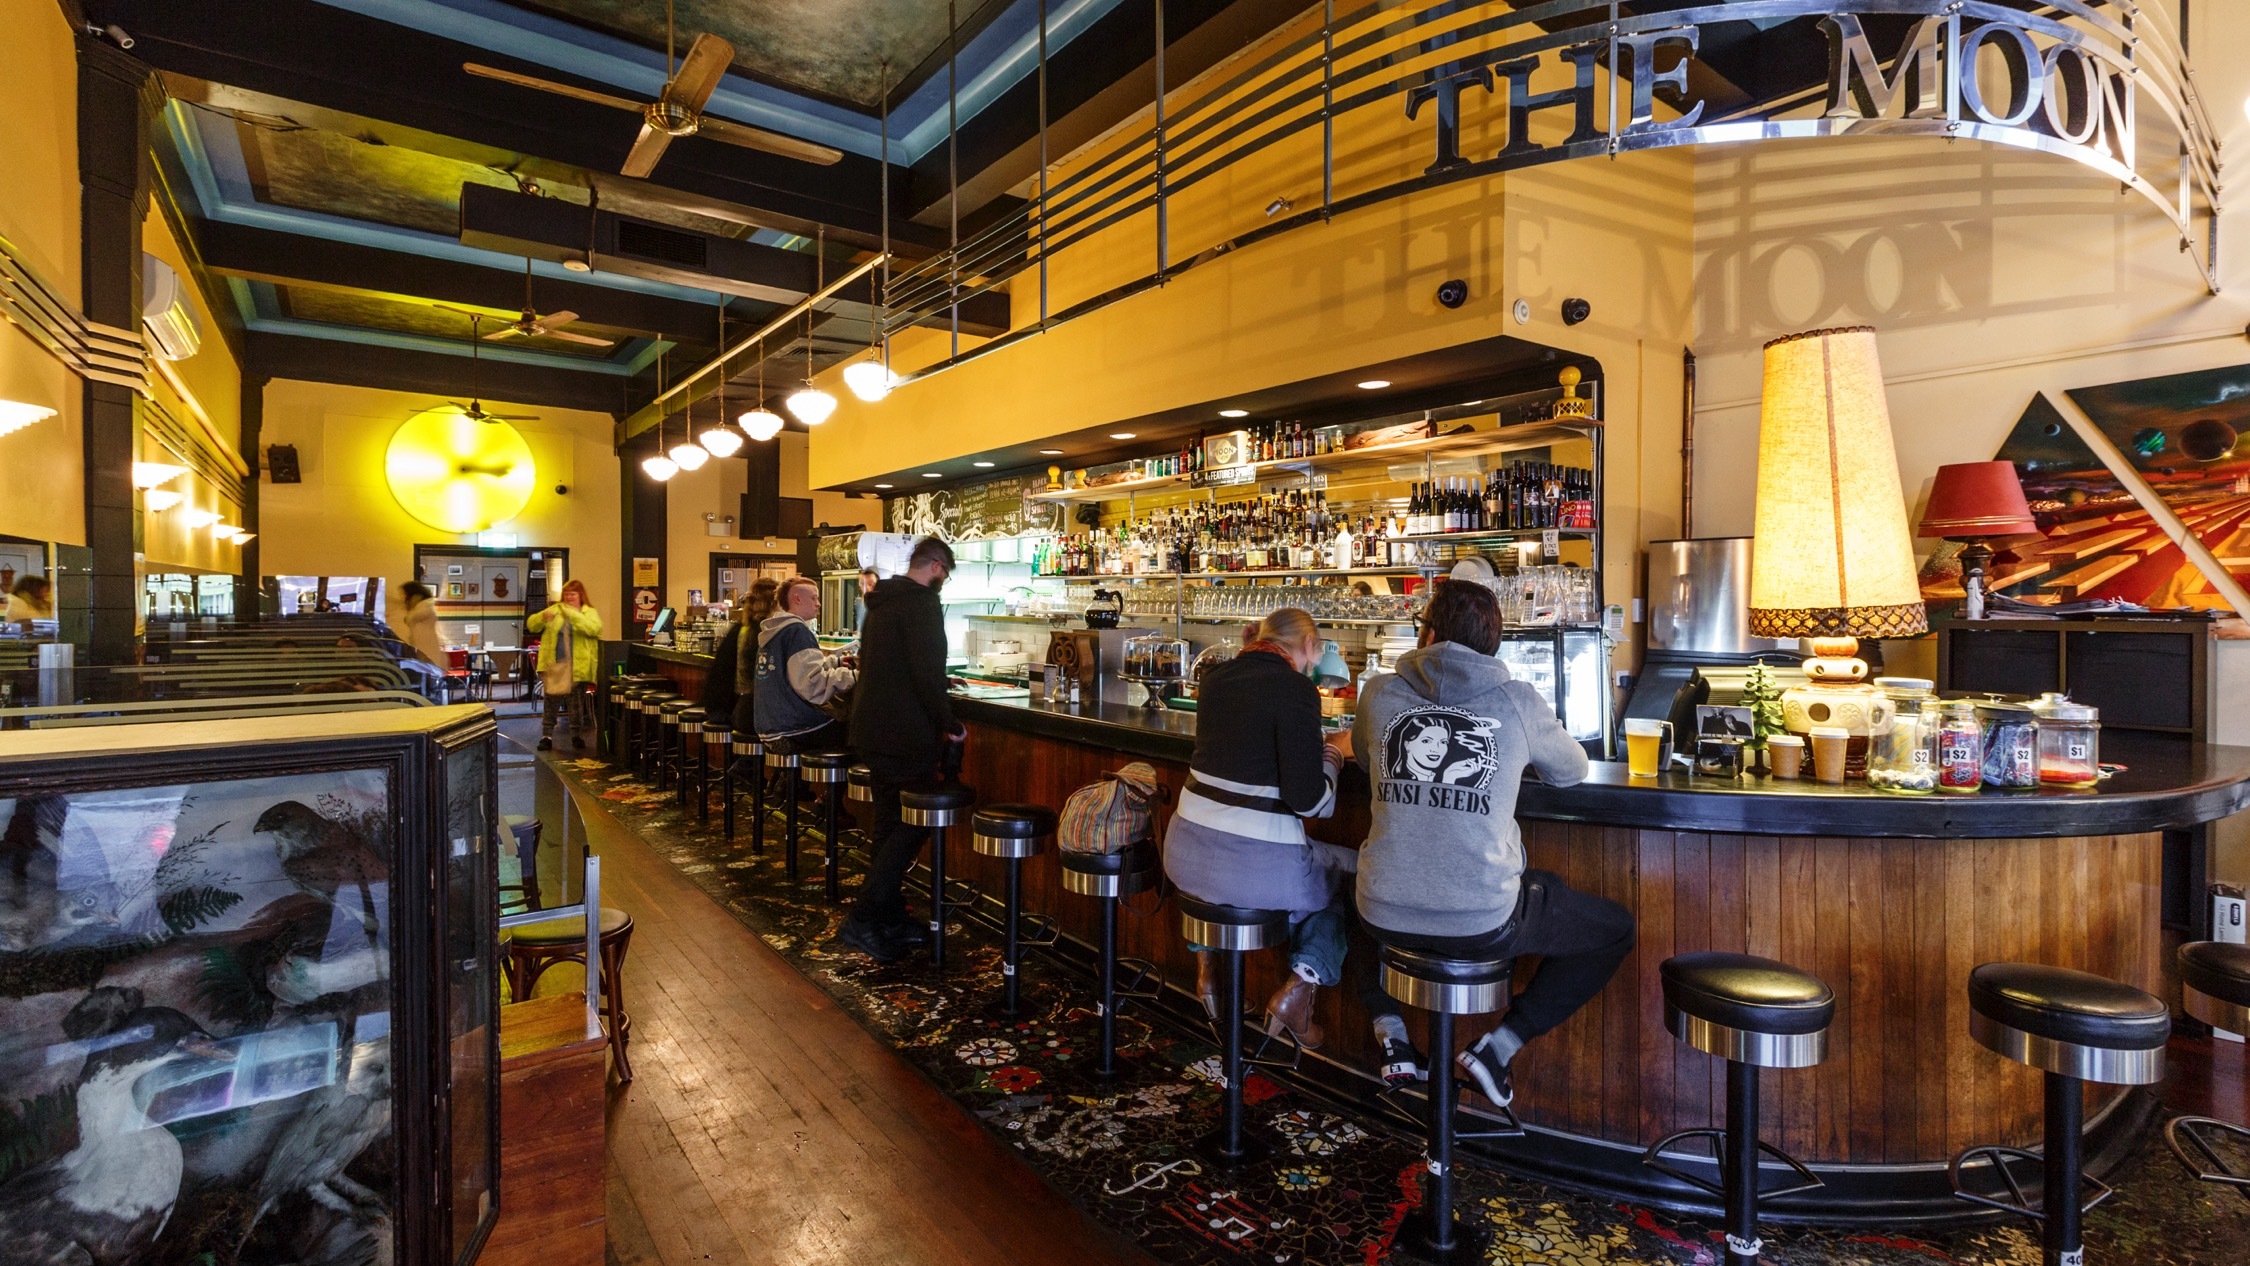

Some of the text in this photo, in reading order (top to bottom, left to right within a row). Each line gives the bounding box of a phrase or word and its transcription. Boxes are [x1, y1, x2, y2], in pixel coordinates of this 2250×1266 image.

[1405, 13, 2136, 175] THE MOON
[1560, 504, 1577, 515] UNO
[1914, 751, 1927, 763] $2
[1952, 749, 1967, 760] $2
[2017, 749, 2029, 760] $2
[2070, 746, 2083, 757] $1
[1377, 782, 1491, 816] SENSI SEEDS
